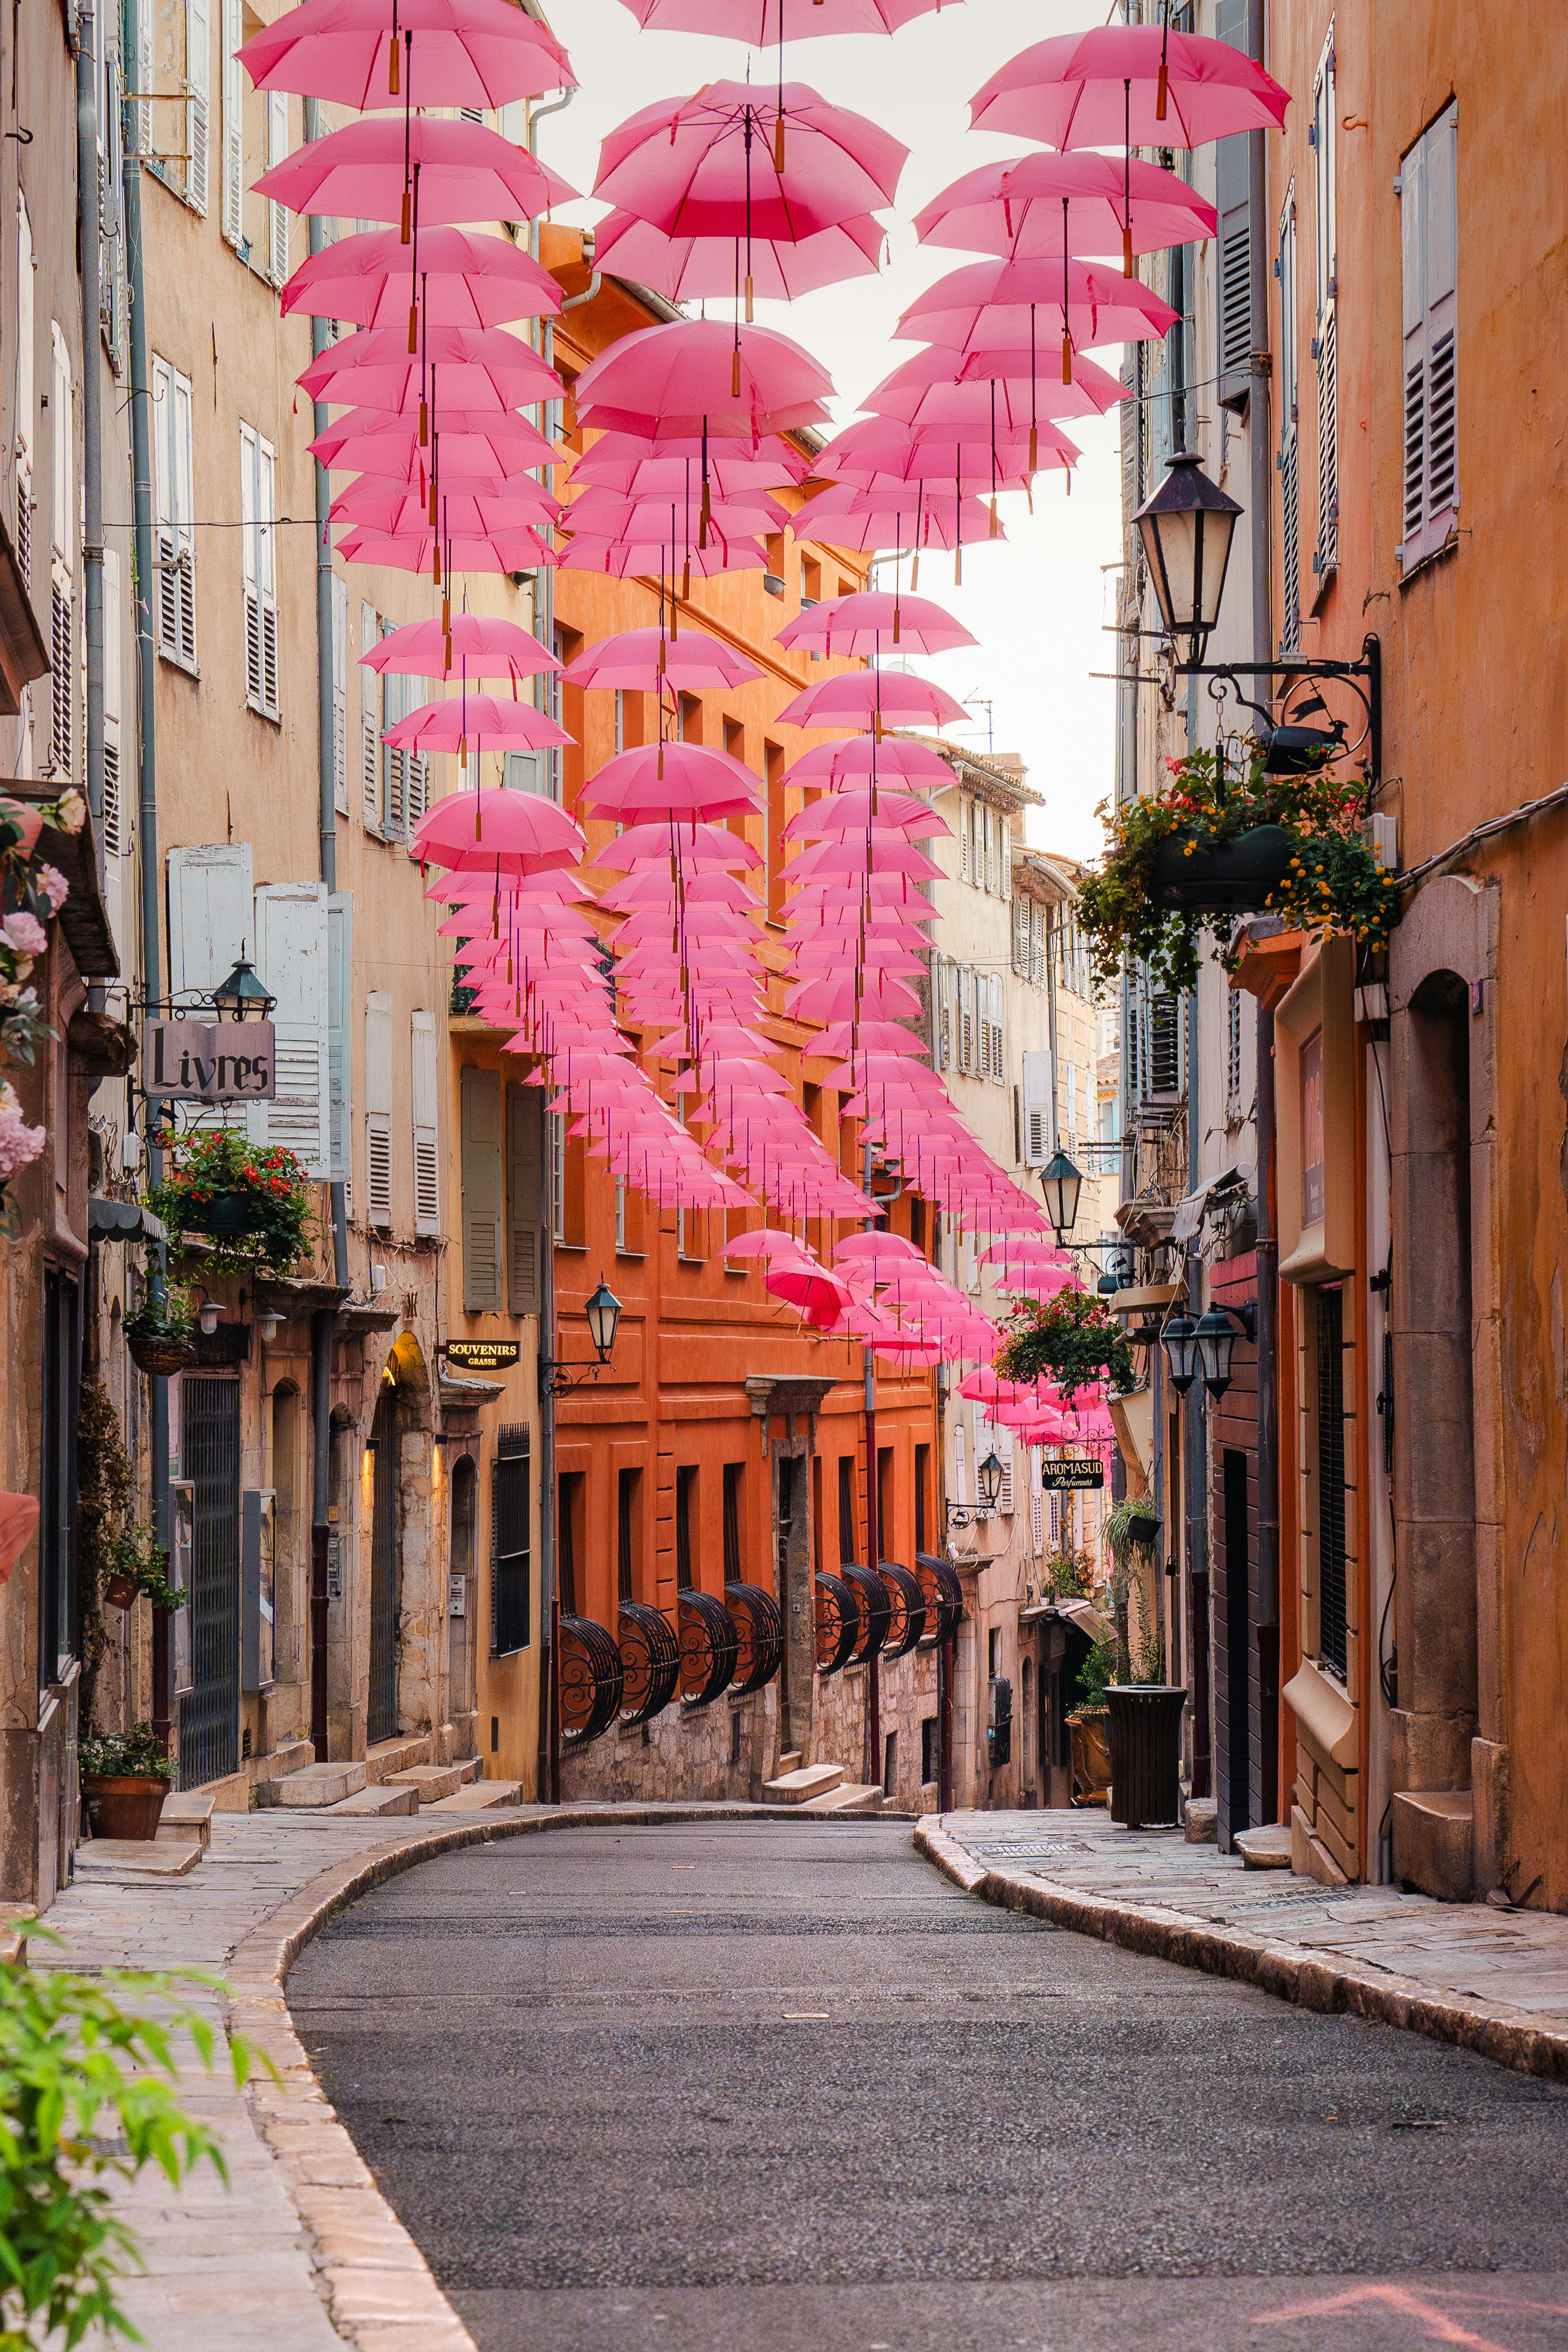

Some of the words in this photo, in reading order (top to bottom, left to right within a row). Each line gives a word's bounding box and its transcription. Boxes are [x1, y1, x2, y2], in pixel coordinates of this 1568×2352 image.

[150, 1026, 268, 1091] Livres
[449, 1344, 516, 1355] SOUVENIRS
[1043, 1463, 1102, 1475] AROMASUD
[1053, 1477, 1093, 1488] Parfumeurs
